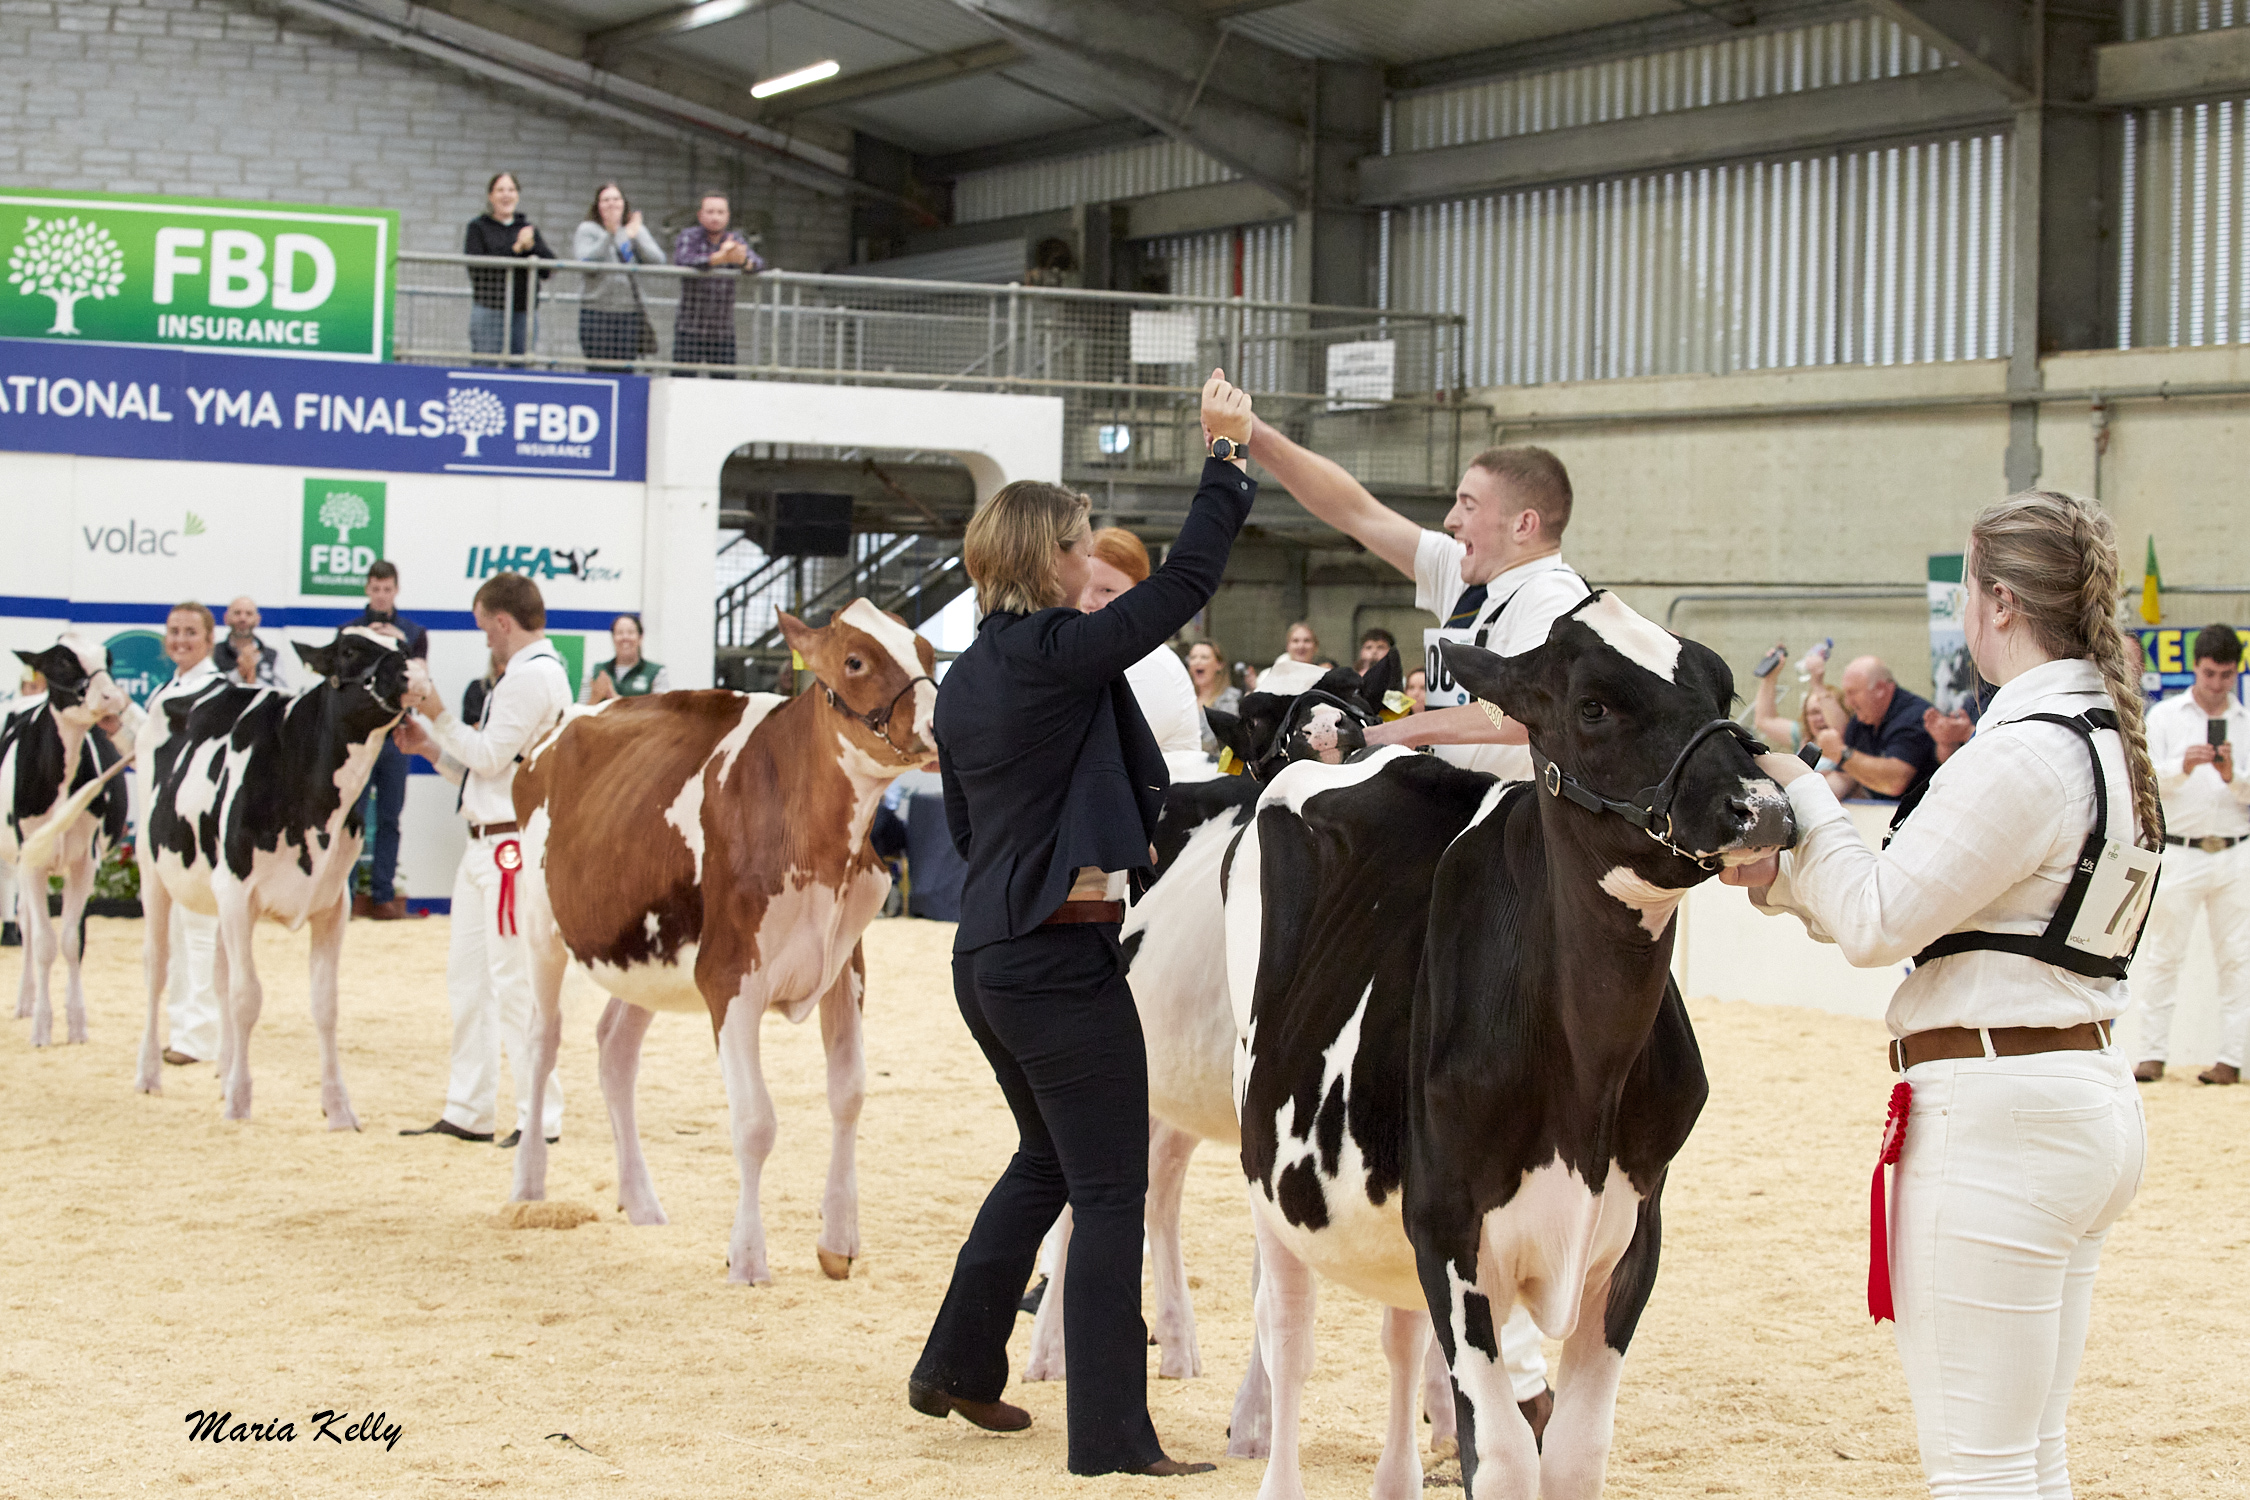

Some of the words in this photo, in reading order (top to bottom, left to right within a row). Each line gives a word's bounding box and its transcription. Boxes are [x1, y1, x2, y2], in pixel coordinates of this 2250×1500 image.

[153, 226, 337, 312] FBD
[157, 314, 321, 345] INSURANCE
[186, 386, 283, 429] YMA
[294, 392, 446, 438] FINALS
[513, 402, 600, 443] FBD
[516, 442, 592, 459] INSURANCE
[83, 518, 178, 557] volac
[310, 543, 376, 575] FBD
[2069, 934, 2086, 946] volac
